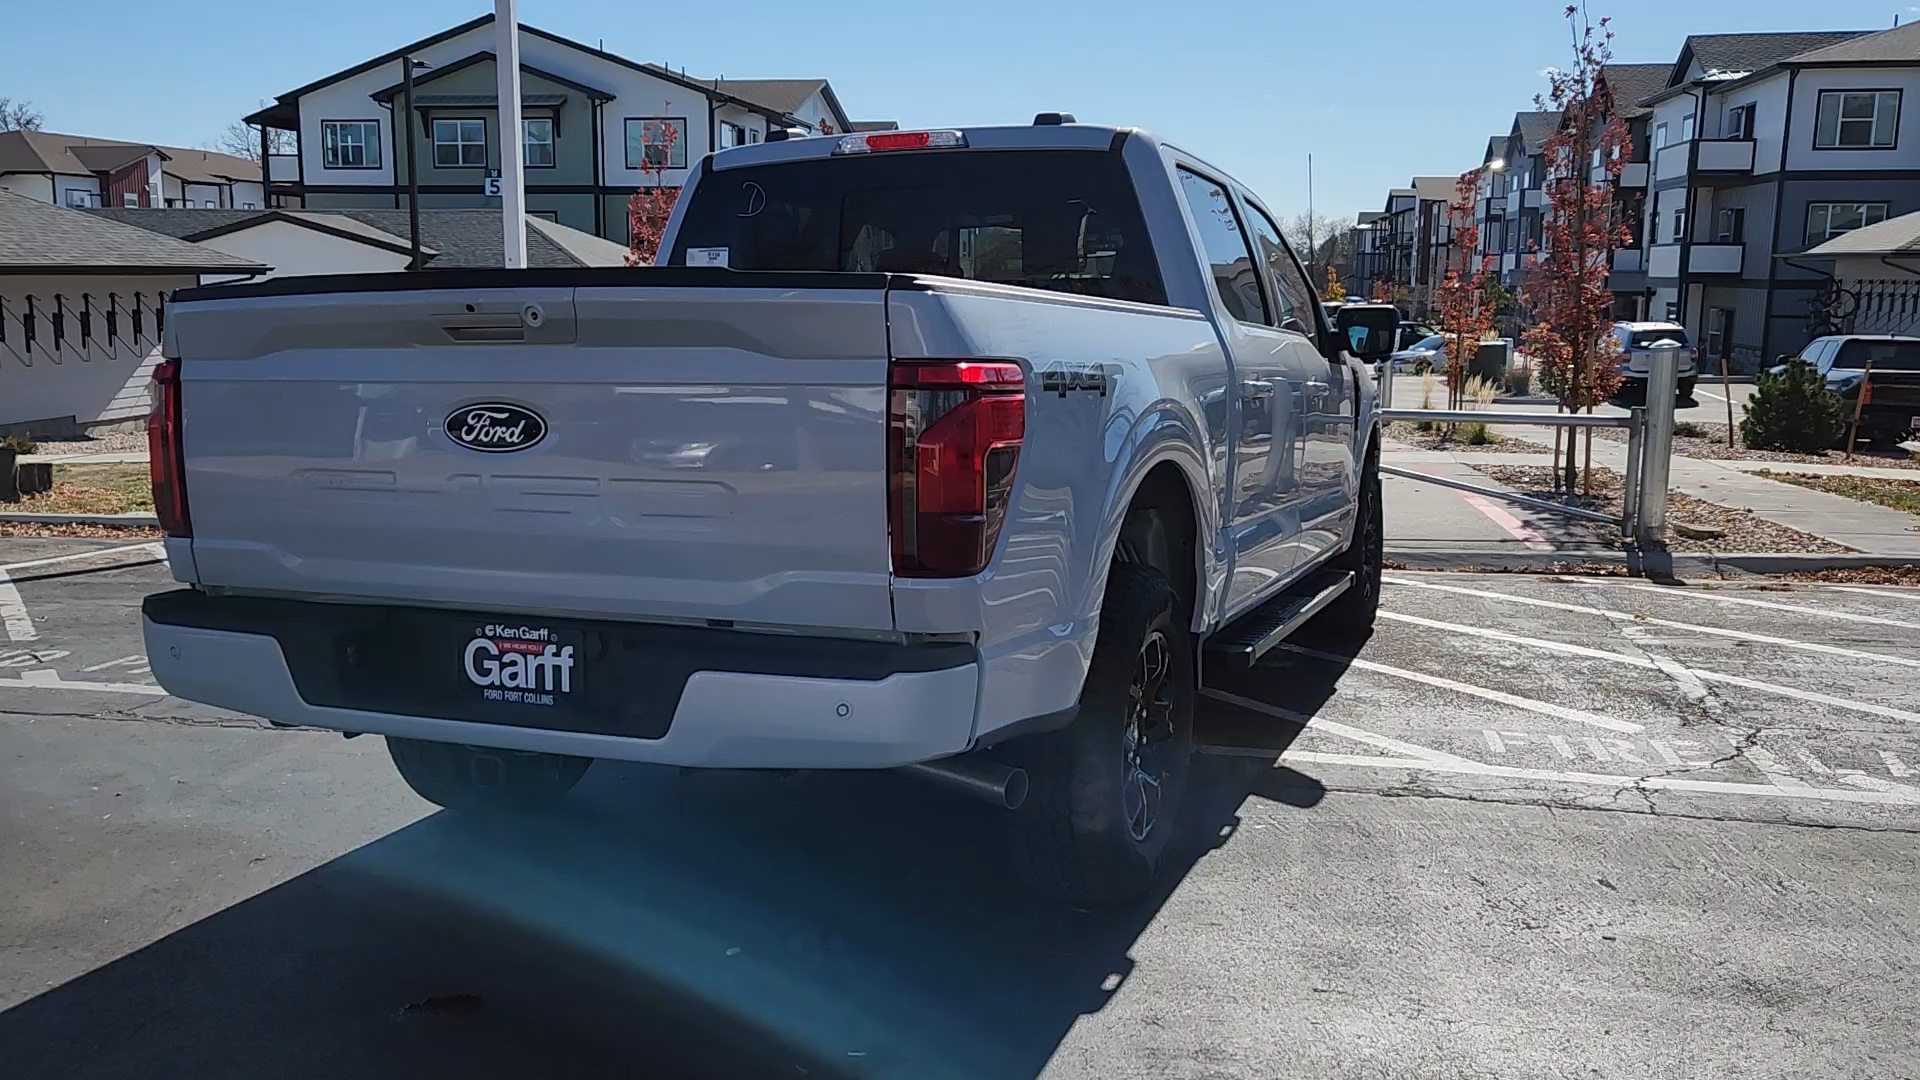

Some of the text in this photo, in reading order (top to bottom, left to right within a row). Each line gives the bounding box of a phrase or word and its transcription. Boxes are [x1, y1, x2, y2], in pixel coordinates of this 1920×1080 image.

[461, 410, 526, 443] Ford
[465, 637, 574, 692] Garff
[484, 689, 554, 706] FORD FORT COLLINS
